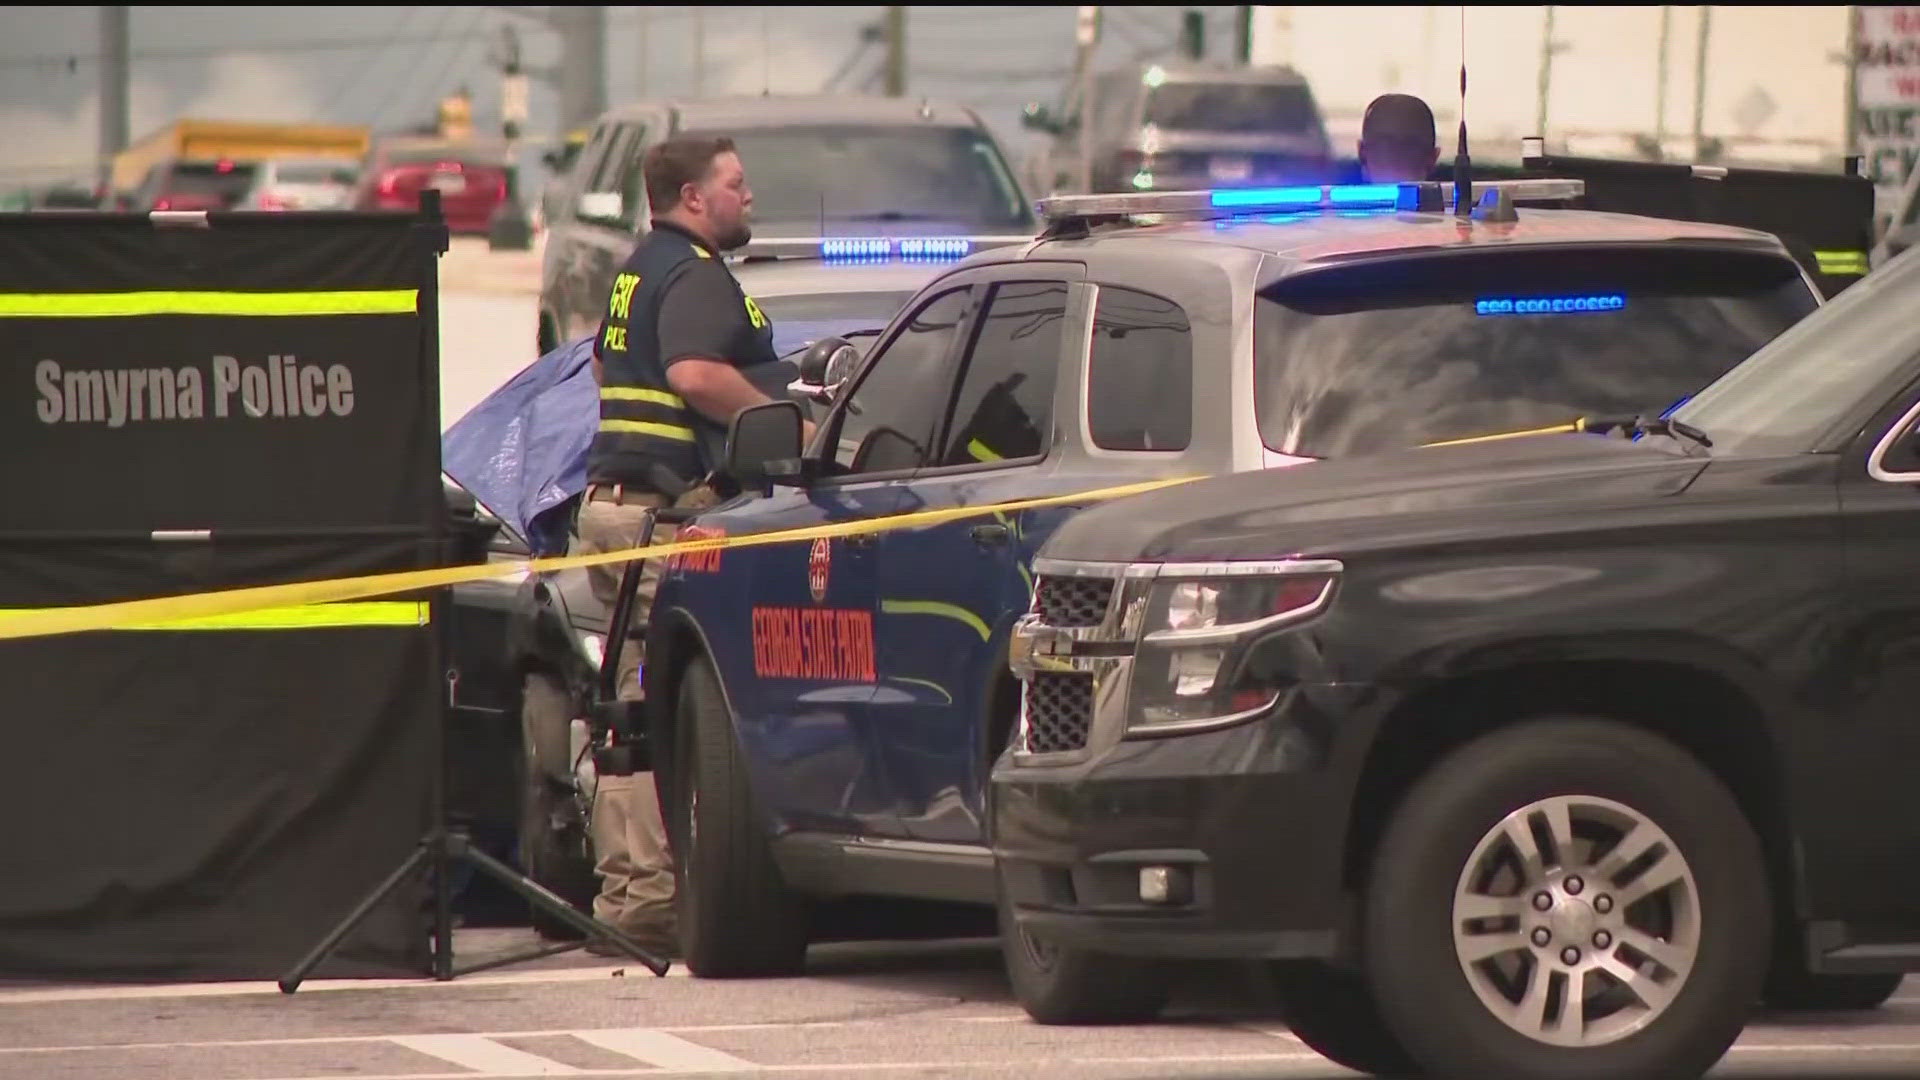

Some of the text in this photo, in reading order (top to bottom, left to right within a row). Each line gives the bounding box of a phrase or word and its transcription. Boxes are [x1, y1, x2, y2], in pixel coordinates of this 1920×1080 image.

[35, 354, 355, 428] Smyrna Police
[752, 606, 877, 682] GEORGIA STATE PATROL
